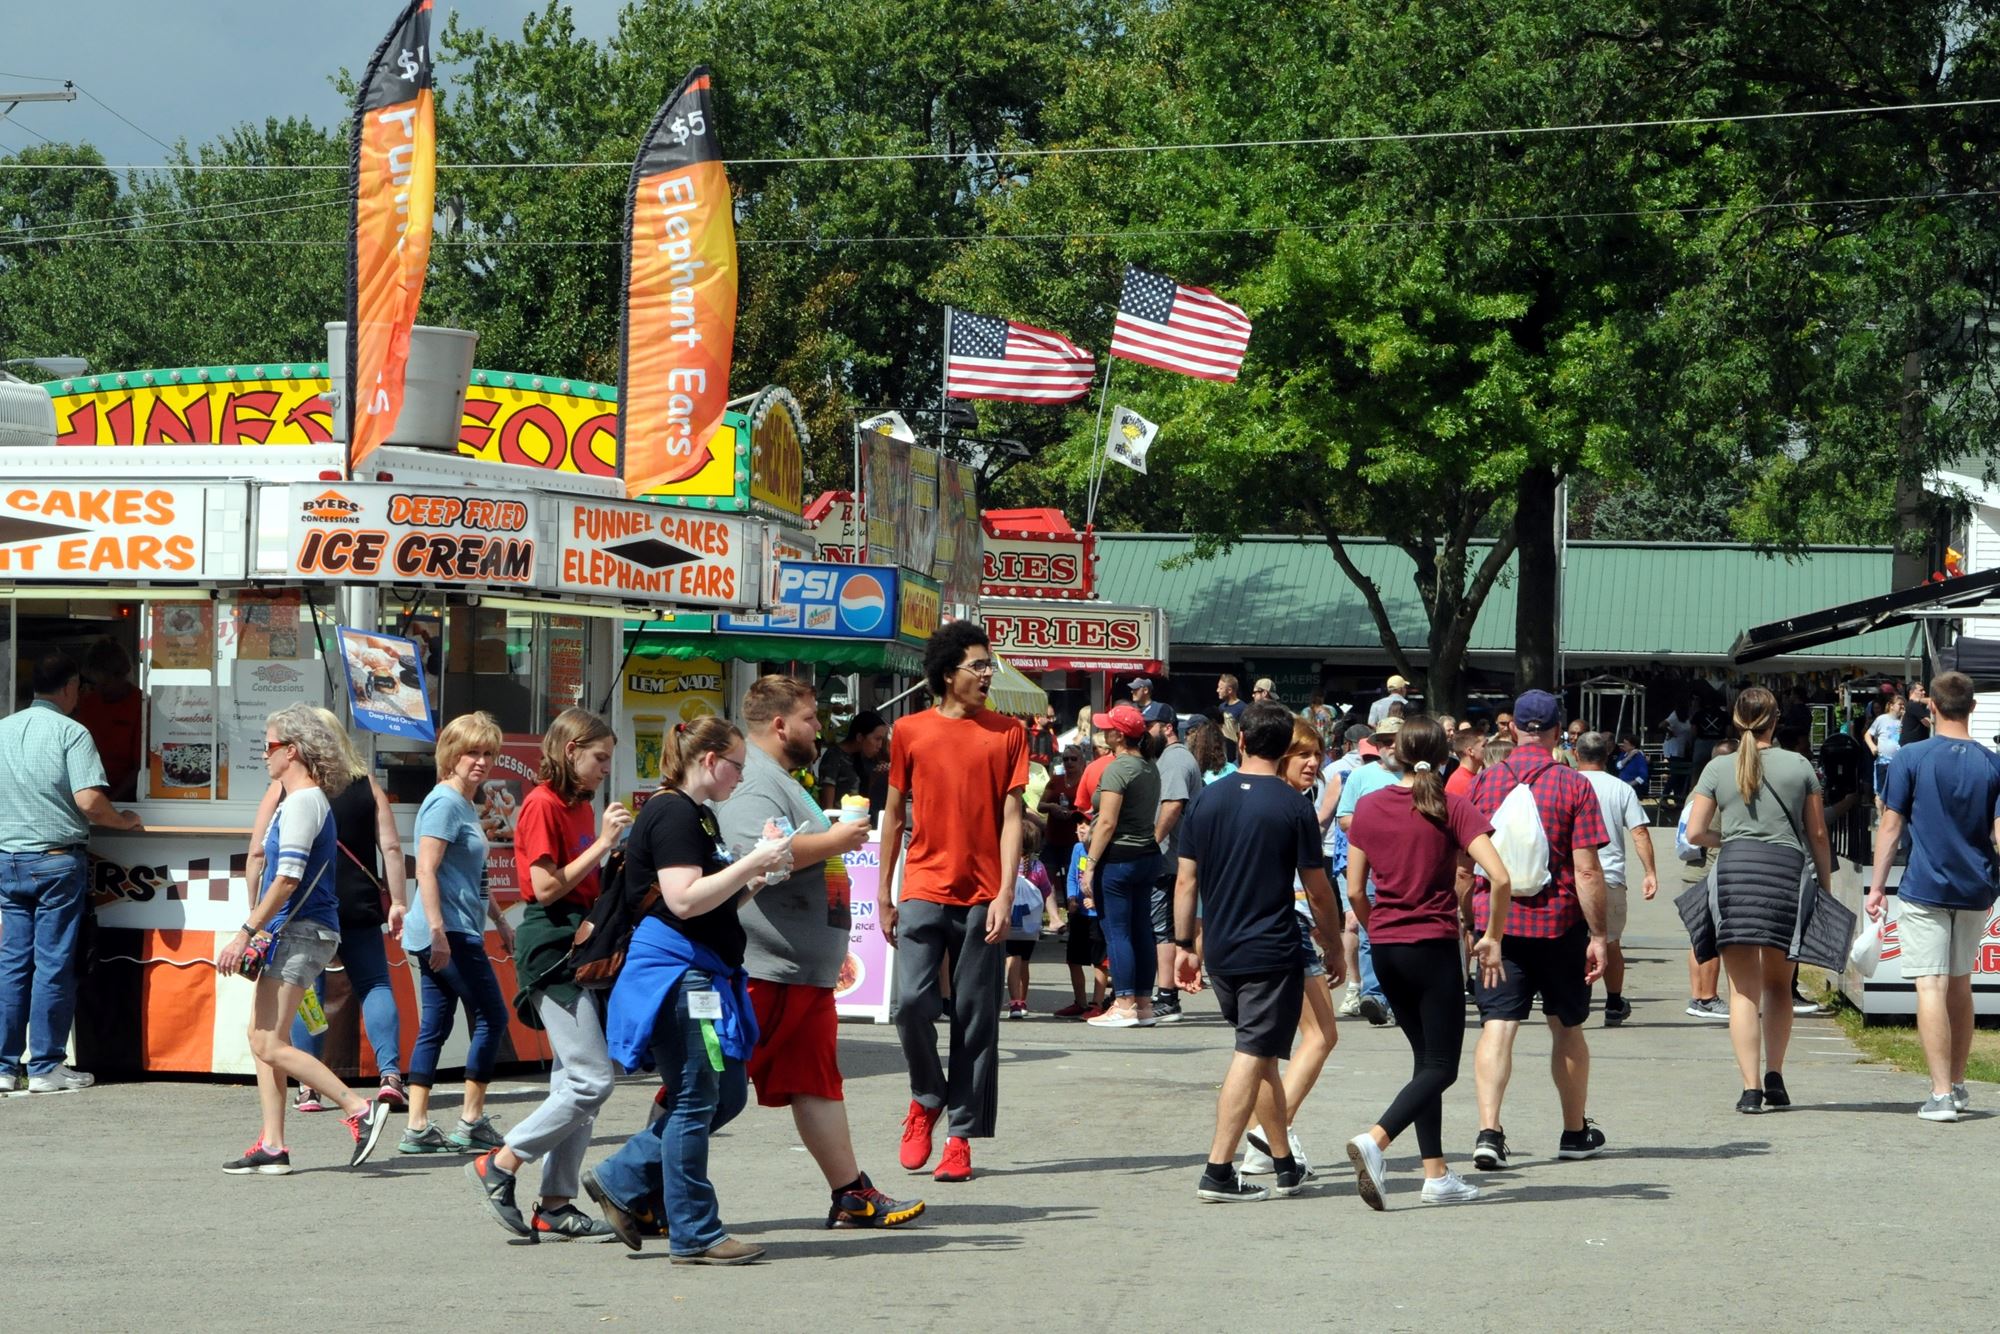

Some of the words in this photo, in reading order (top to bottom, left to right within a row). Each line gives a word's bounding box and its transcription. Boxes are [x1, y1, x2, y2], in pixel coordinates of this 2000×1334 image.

[670, 110, 706, 146] $5
[657, 175, 705, 349] Elephant
[666, 367, 706, 457] Ears
[6, 488, 175, 526] CAKES
[301, 515, 361, 524] CONCESSIONS
[303, 497, 359, 513] BYERS
[388, 494, 463, 528] DEEP
[462, 499, 527, 532] FRIED
[573, 506, 654, 542] FUNNEL
[661, 516, 729, 557] CAKES
[57, 534, 195, 572] EARS
[298, 530, 388, 575] ICE
[394, 531, 534, 581] CREAM
[563, 548, 674, 594] ELEPHANT
[680, 565, 735, 600] EARS
[780, 568, 840, 600] PSI
[552, 639, 582, 648] APPLE
[981, 615, 1140, 650] FRIES
[252, 683, 304, 693] Concessions
[1274, 674, 1321, 685] LAKERS
[487, 874, 511, 887] ndwich
[855, 922, 876, 931] RICE
